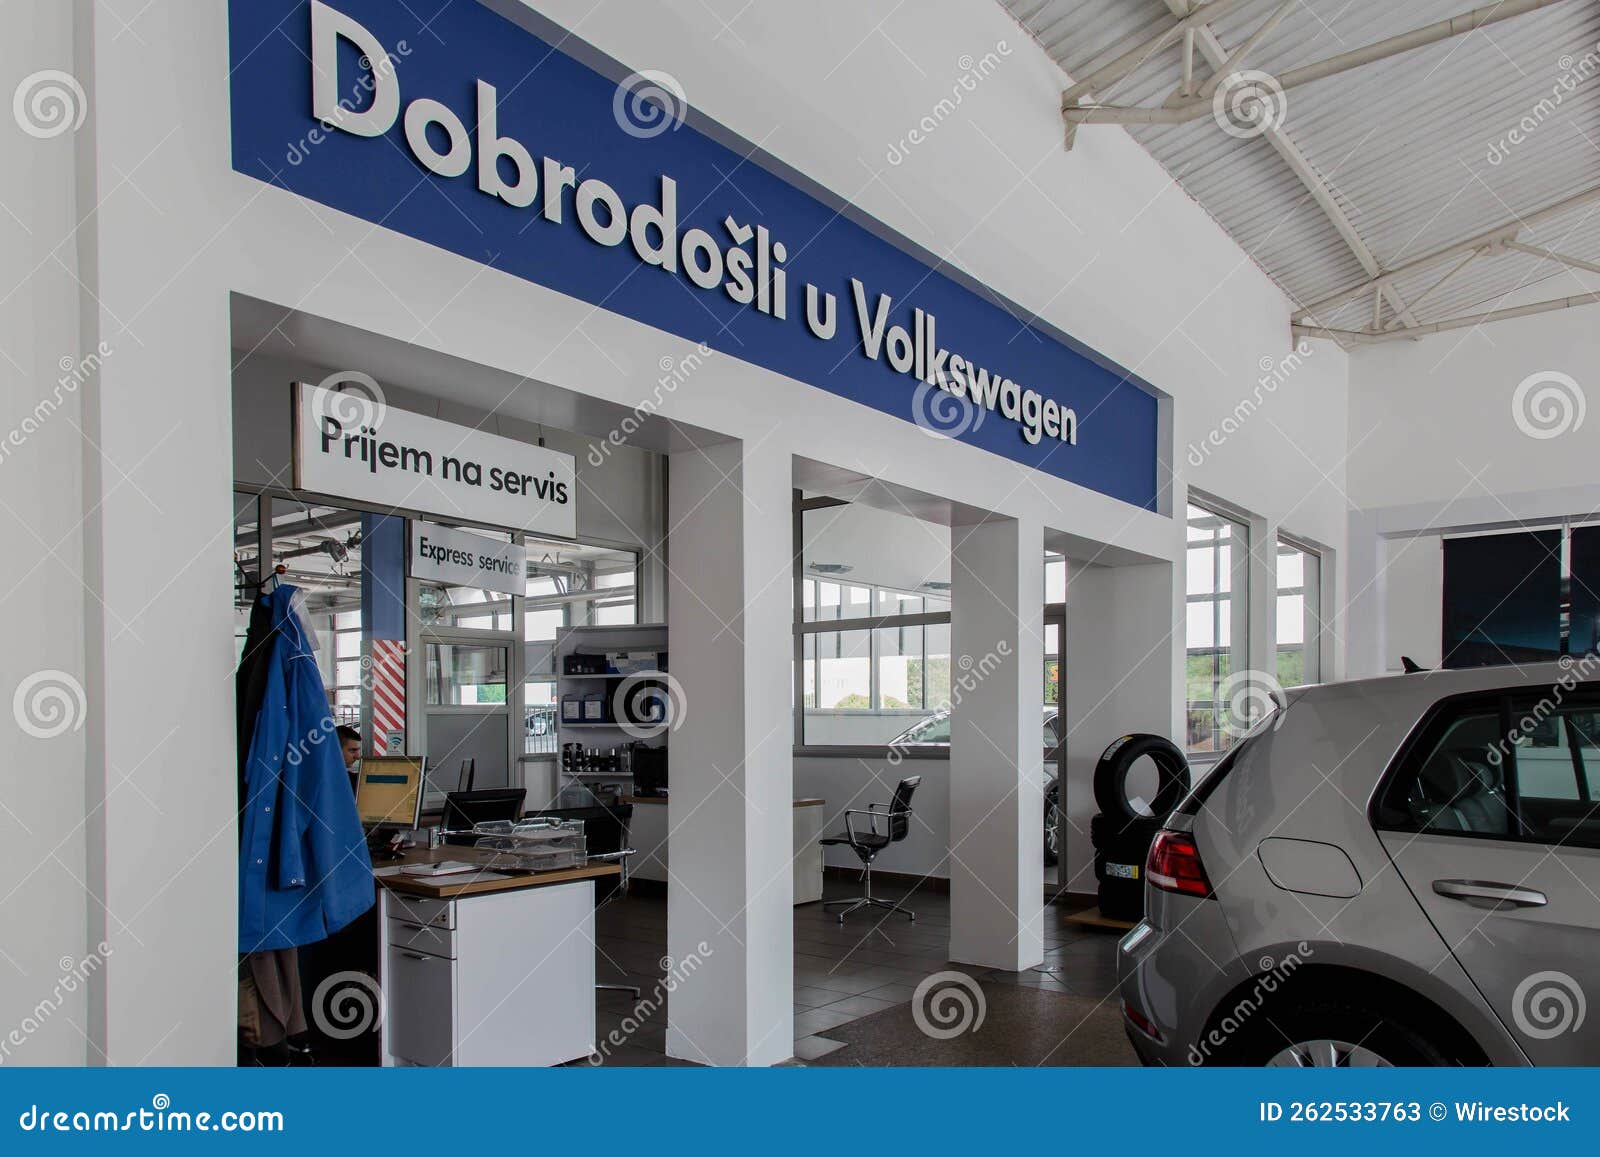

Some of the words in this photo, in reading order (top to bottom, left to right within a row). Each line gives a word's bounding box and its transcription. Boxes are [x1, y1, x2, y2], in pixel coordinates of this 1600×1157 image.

[310, 0, 787, 321] Dobrodošli
[805, 283, 837, 341] u
[850, 277, 1078, 446] Volkswagen
[320, 415, 433, 476] Prijem
[442, 455, 482, 487] na
[489, 471, 568, 505] servis
[420, 536, 473, 565] Express
[478, 555, 521, 576] service
